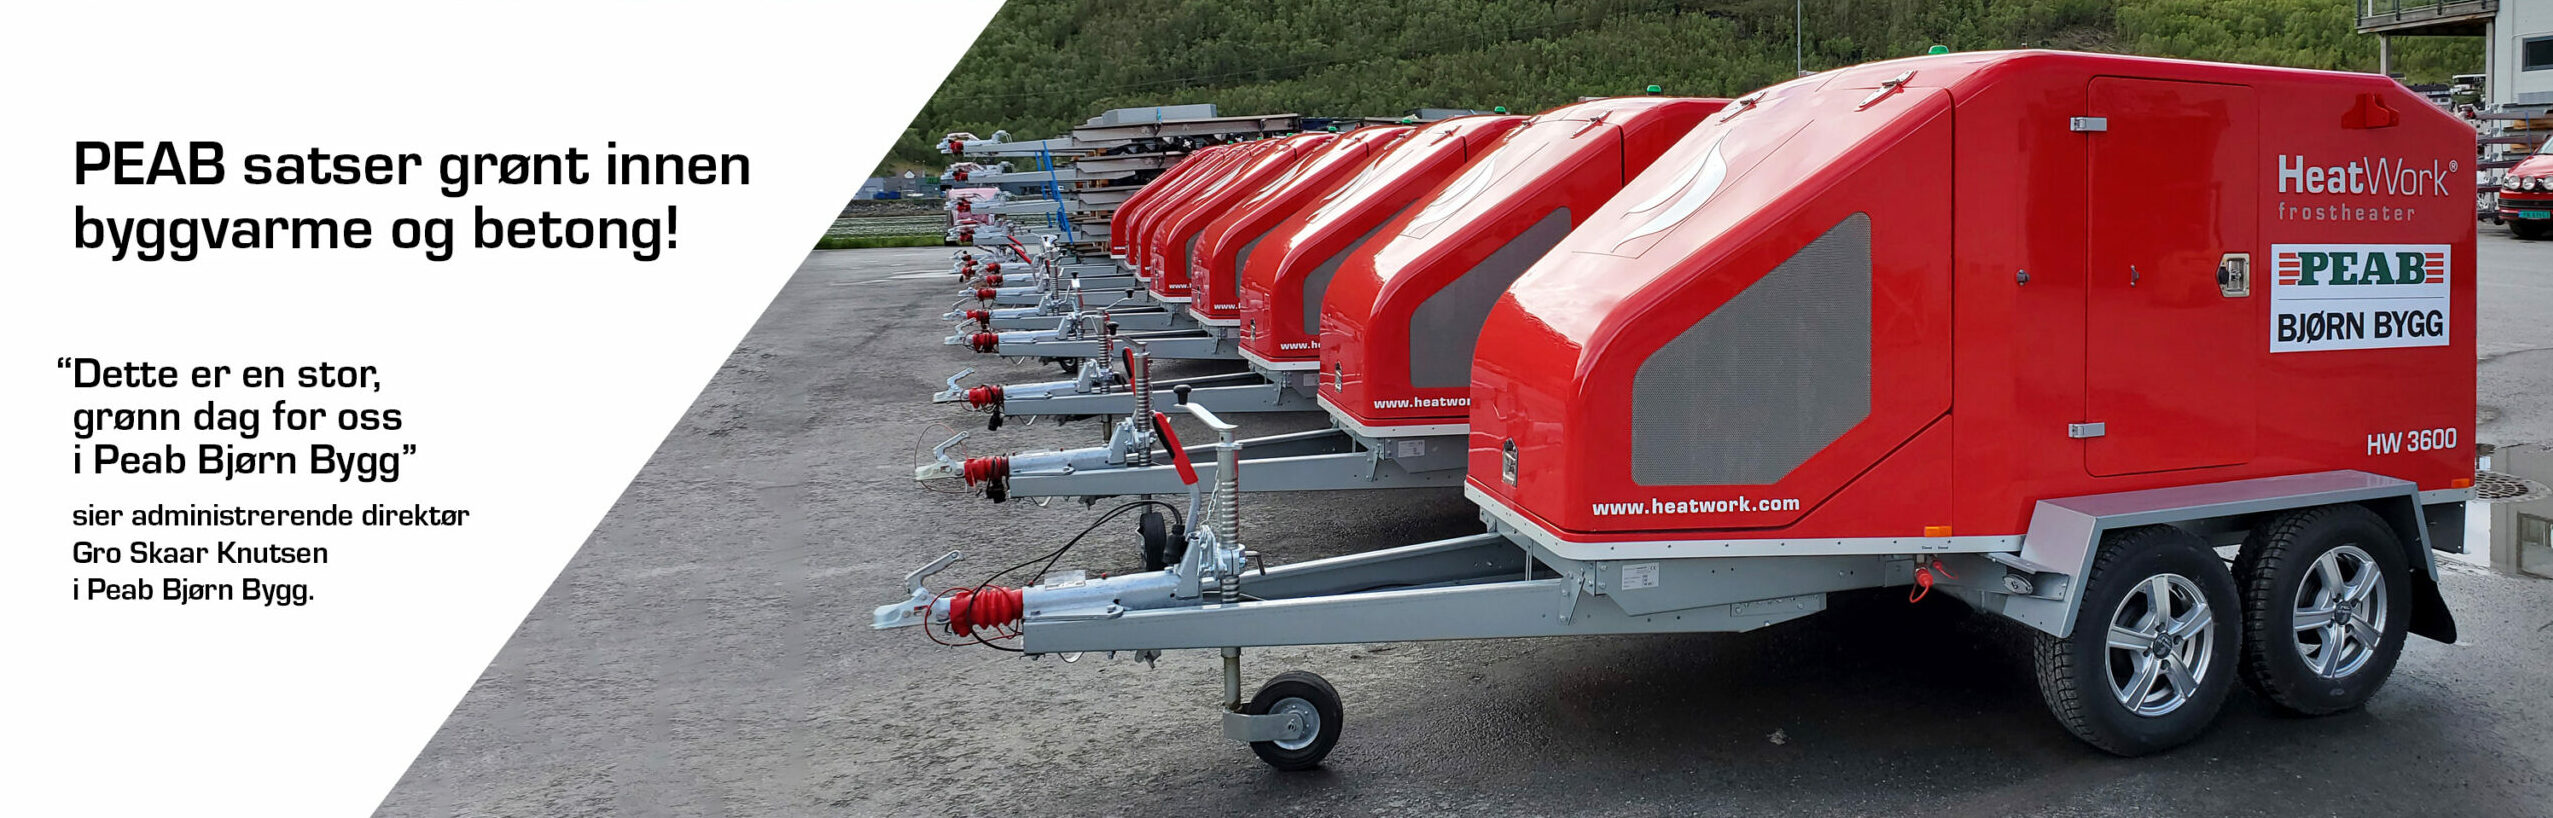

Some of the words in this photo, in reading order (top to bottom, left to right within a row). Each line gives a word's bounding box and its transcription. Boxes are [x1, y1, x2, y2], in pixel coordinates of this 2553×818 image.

[2278, 201, 2416, 222] frostheater
[2297, 251, 2427, 286] PEAB
[2278, 310, 2365, 344] BJØRN
[2374, 309, 2444, 339] BYGG
[2367, 431, 2403, 456] HW
[2407, 427, 2457, 452] 3600
[1592, 496, 1800, 516] www.heatwork.com
